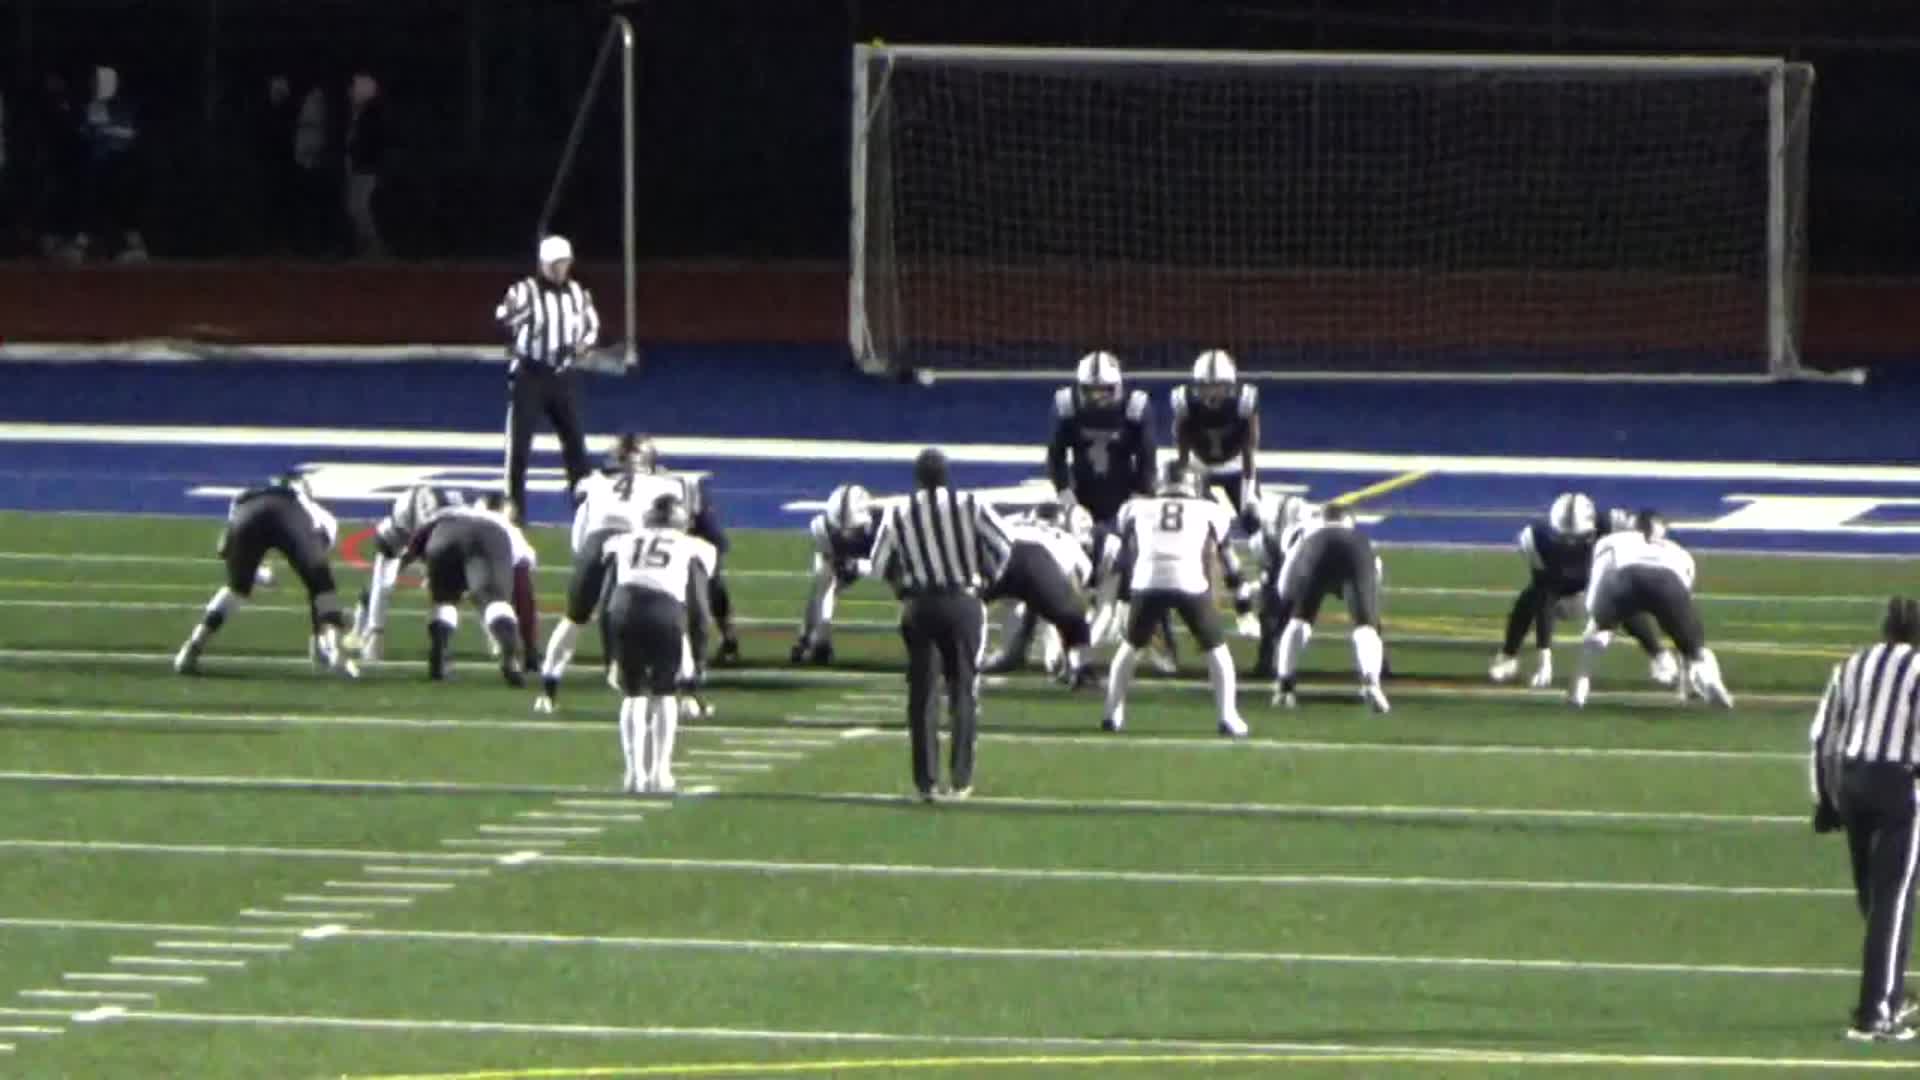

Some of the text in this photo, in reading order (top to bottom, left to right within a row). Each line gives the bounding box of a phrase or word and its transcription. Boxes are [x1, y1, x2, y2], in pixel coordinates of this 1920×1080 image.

[612, 475, 635, 501] 4
[1160, 502, 1184, 532] 8
[630, 536, 673, 569] 15
